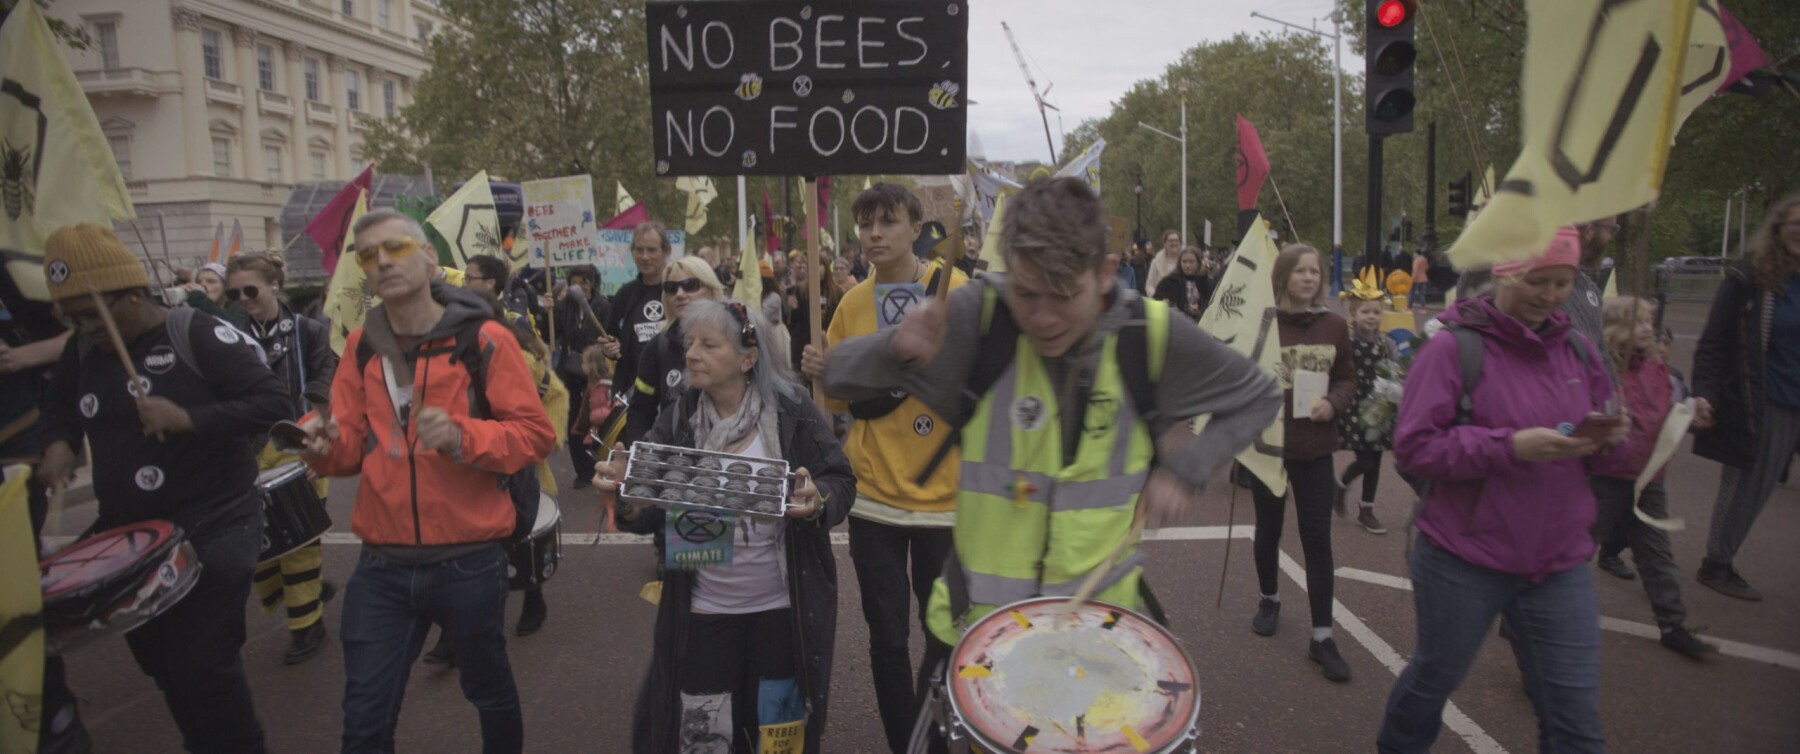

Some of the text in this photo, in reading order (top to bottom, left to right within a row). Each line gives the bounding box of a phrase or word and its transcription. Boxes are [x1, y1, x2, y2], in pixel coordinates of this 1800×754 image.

[661, 15, 951, 72] NO BEES,
[666, 105, 949, 157] NO FOOD.
[527, 204, 555, 218] BEES
[559, 236, 591, 250] MAKE
[605, 230, 631, 244] SAVE
[553, 248, 585, 262] LIFE
[675, 549, 722, 562] CLIMATE
[767, 726, 799, 738] REBEL
[773, 738, 790, 749] FOR
